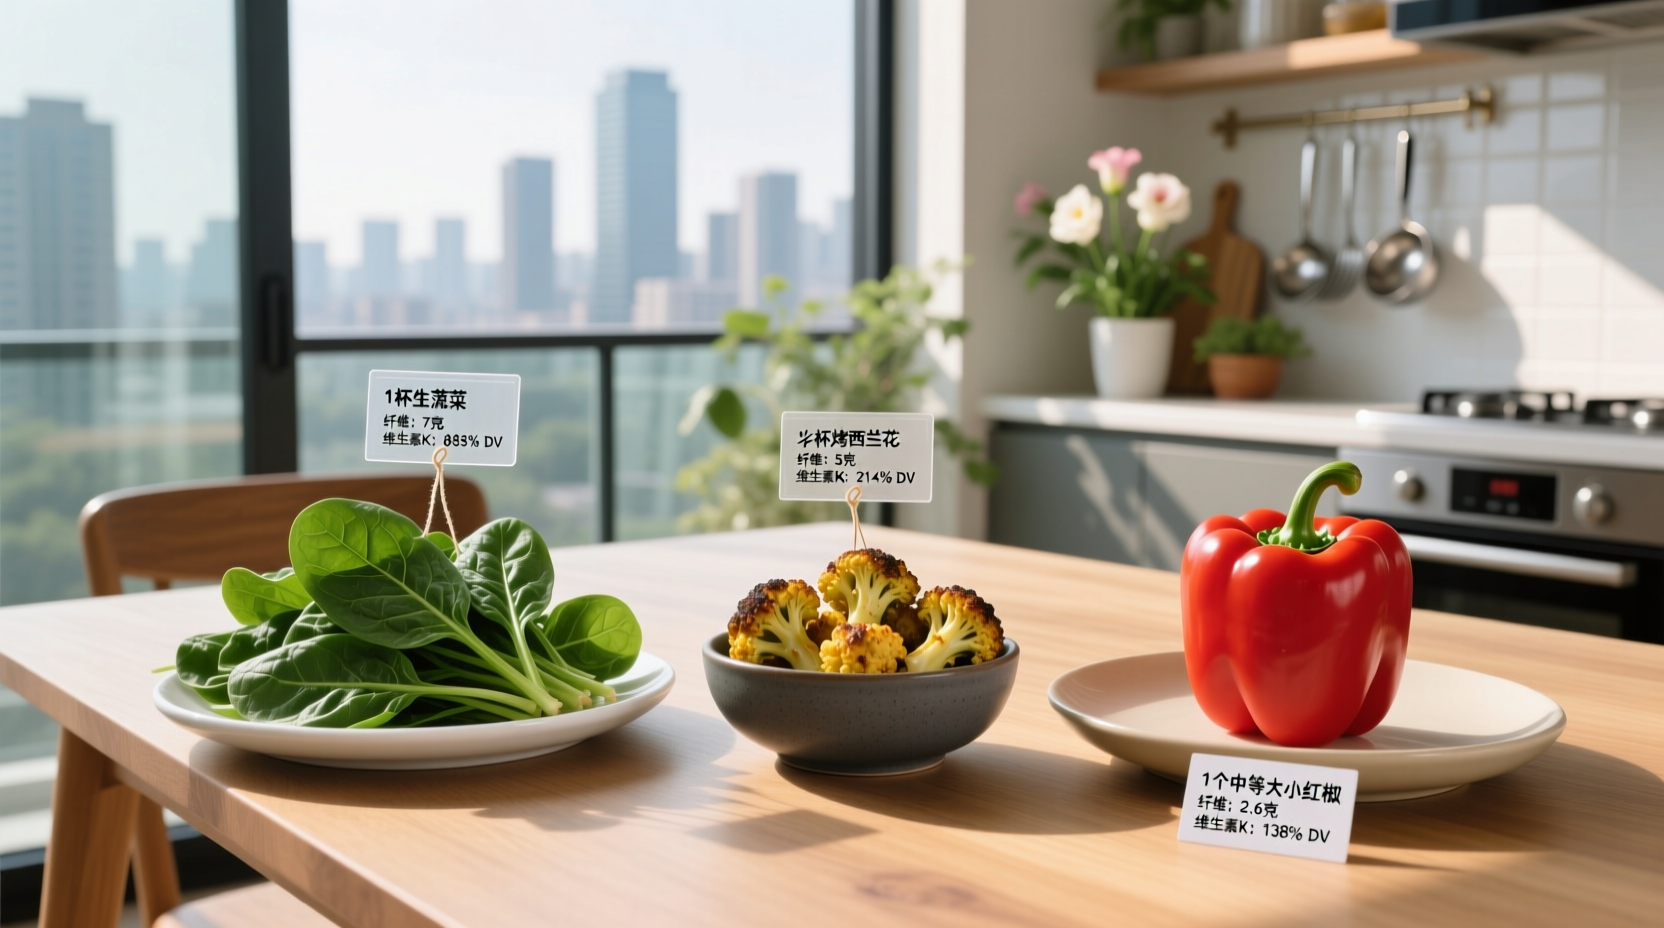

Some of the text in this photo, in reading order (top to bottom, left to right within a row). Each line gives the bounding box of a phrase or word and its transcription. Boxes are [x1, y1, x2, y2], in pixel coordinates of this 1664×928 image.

[484, 435, 503, 448] DV
[896, 471, 916, 484] DV
[1201, 771, 1342, 805] 1个中等大小红椒
[1307, 828, 1331, 843] DV
